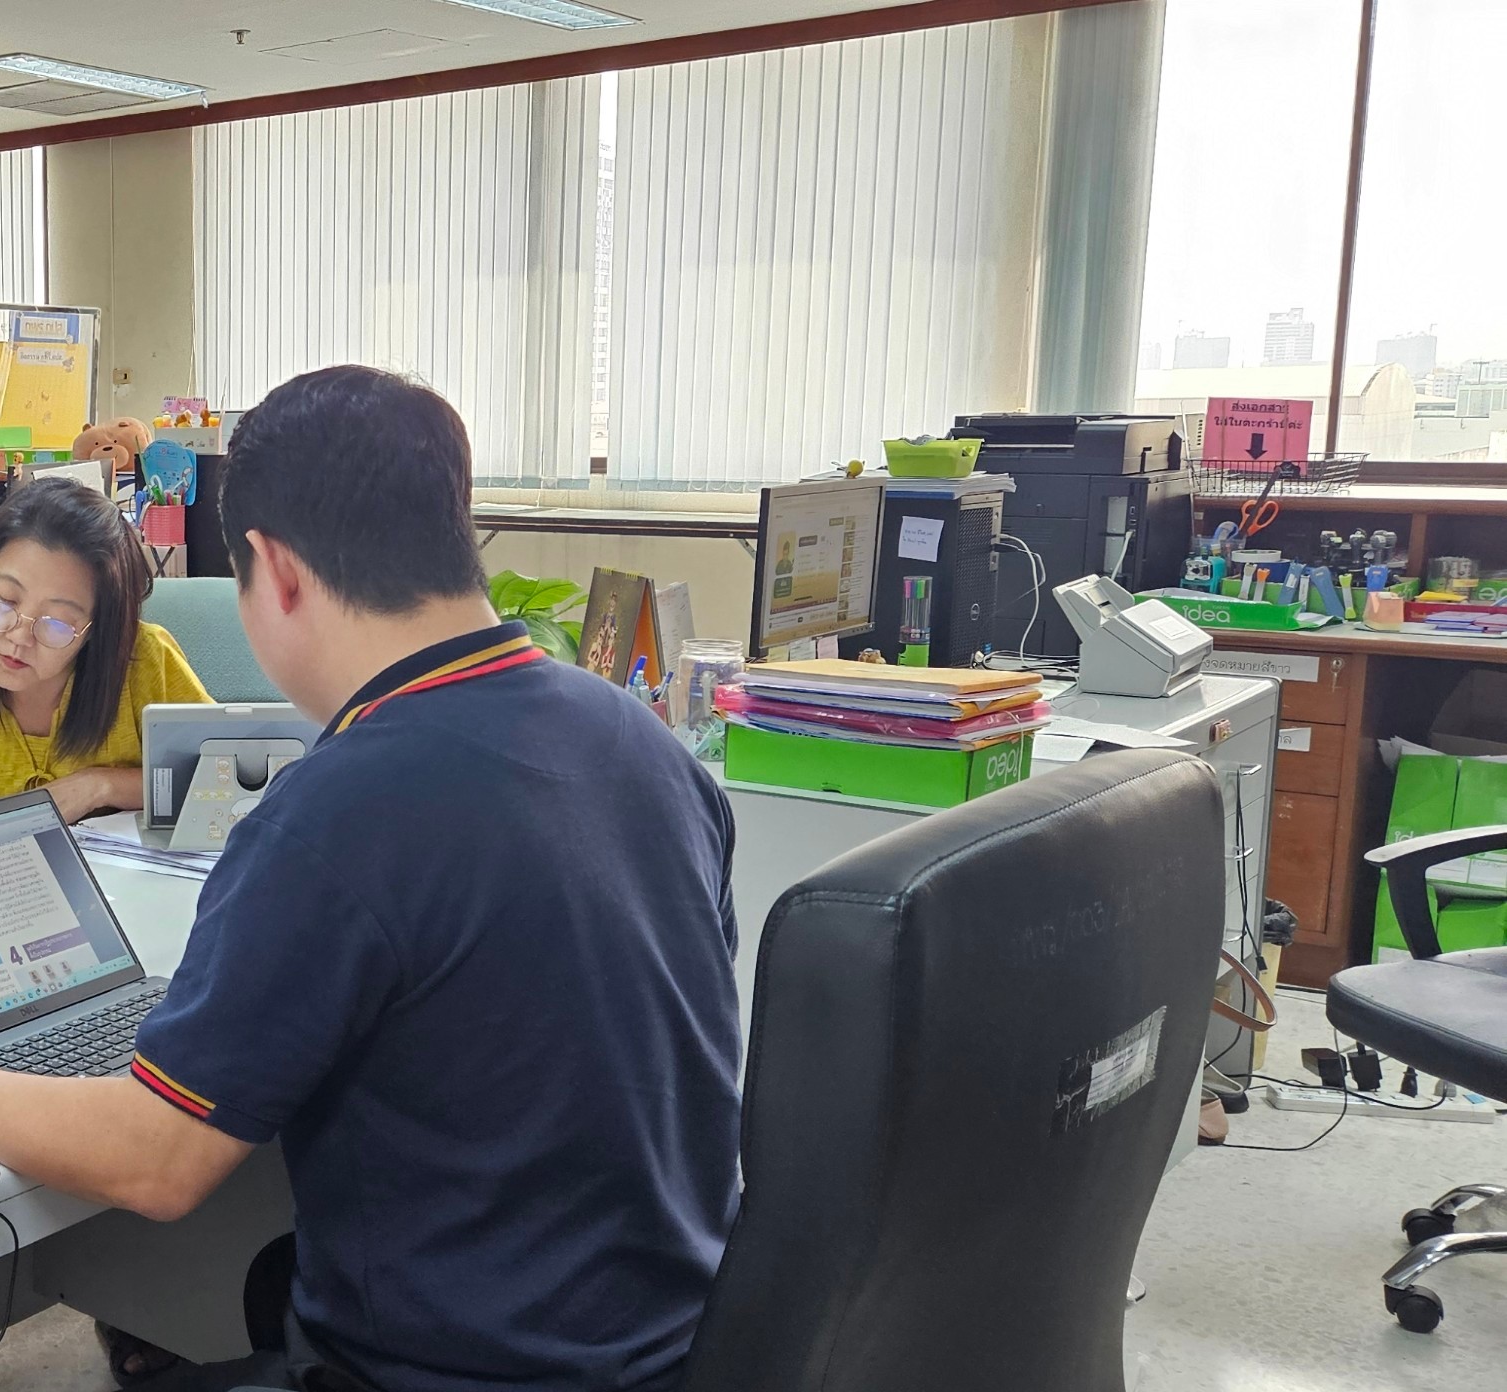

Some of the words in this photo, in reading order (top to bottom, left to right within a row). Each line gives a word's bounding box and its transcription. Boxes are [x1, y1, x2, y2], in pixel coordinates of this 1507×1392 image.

[1182, 604, 1231, 623] idea
[986, 746, 1020, 785] idea
[9, 945, 24, 966] 4
[19, 1004, 40, 1017] DELL
